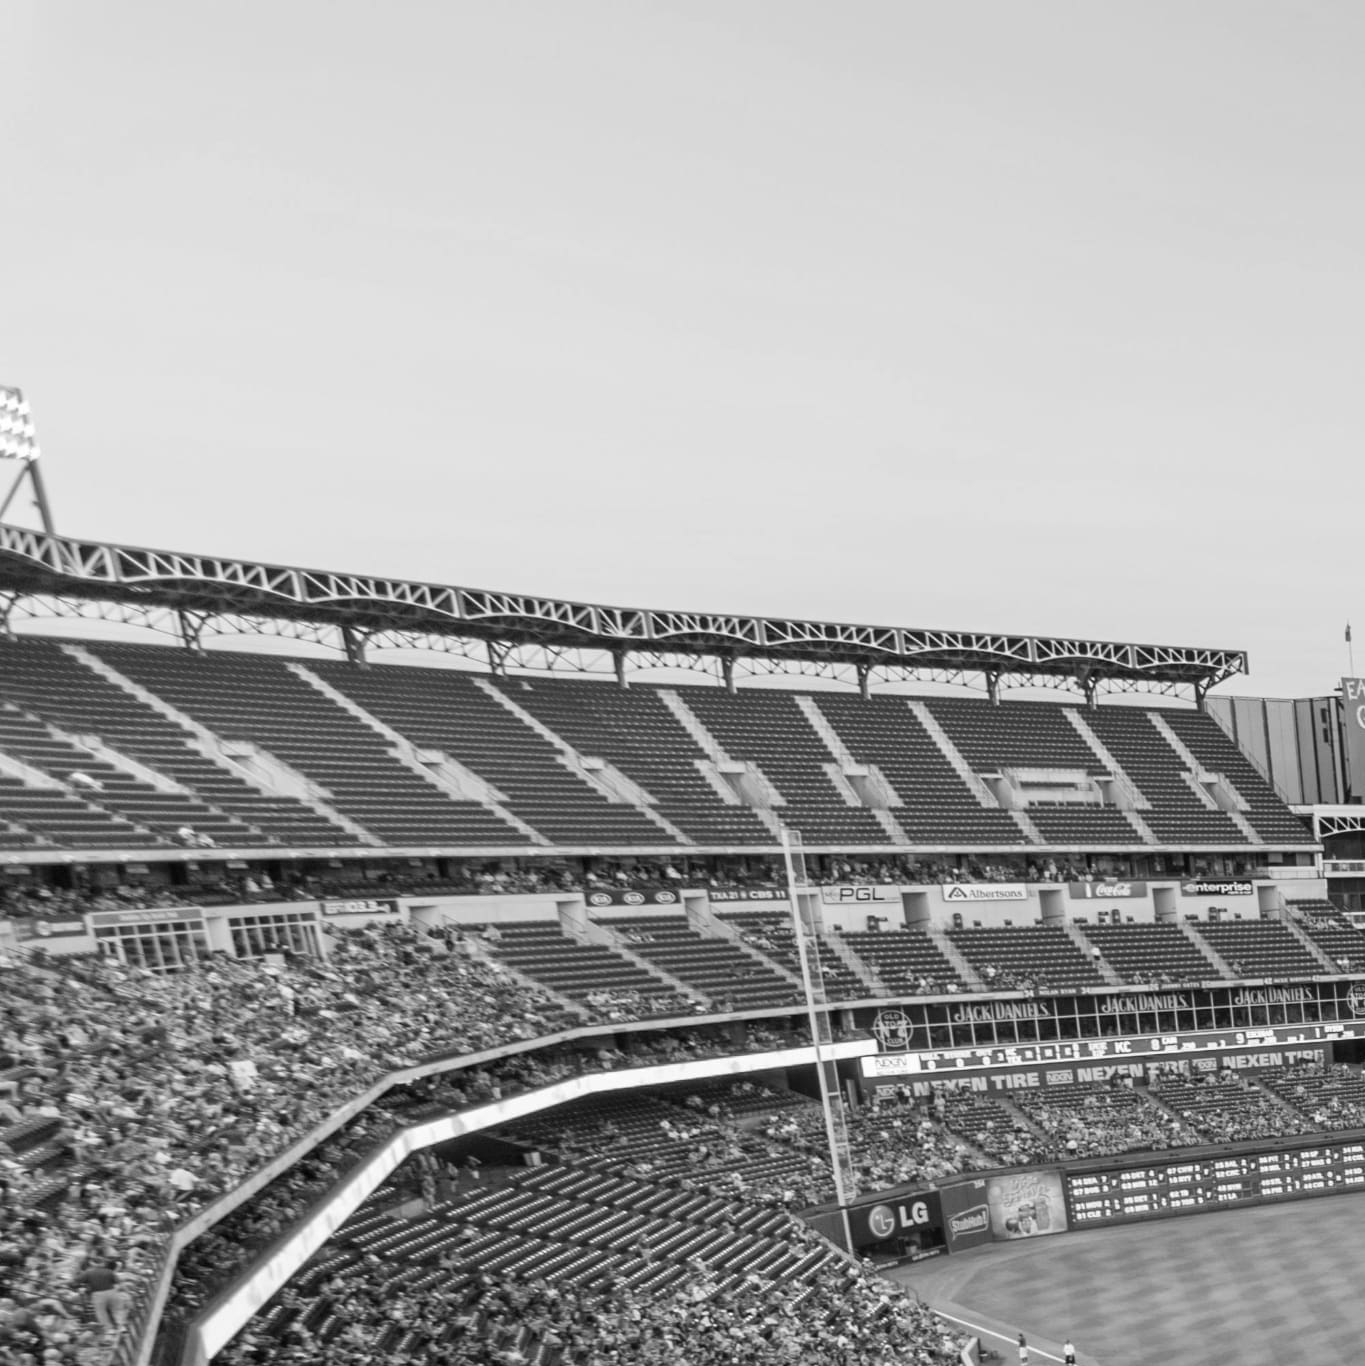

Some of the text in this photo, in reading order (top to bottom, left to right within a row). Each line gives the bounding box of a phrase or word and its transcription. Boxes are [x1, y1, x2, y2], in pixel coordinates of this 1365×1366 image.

[711, 891, 726, 900] TXA
[750, 890, 786, 900] CBS 11
[839, 887, 885, 901] PGL
[969, 888, 1023, 899] Albertsons
[1185, 881, 1252, 896] enterprise
[1101, 995, 1135, 1013] JACK
[1235, 988, 1266, 1005] JACK
[954, 1004, 993, 1022] JACK
[1115, 1041, 1132, 1053] KC
[1223, 1052, 1283, 1069] NEXEN
[991, 1073, 1040, 1090] TIRE
[1078, 1064, 1143, 1082] NEXEN
[898, 1201, 929, 1228] LG
